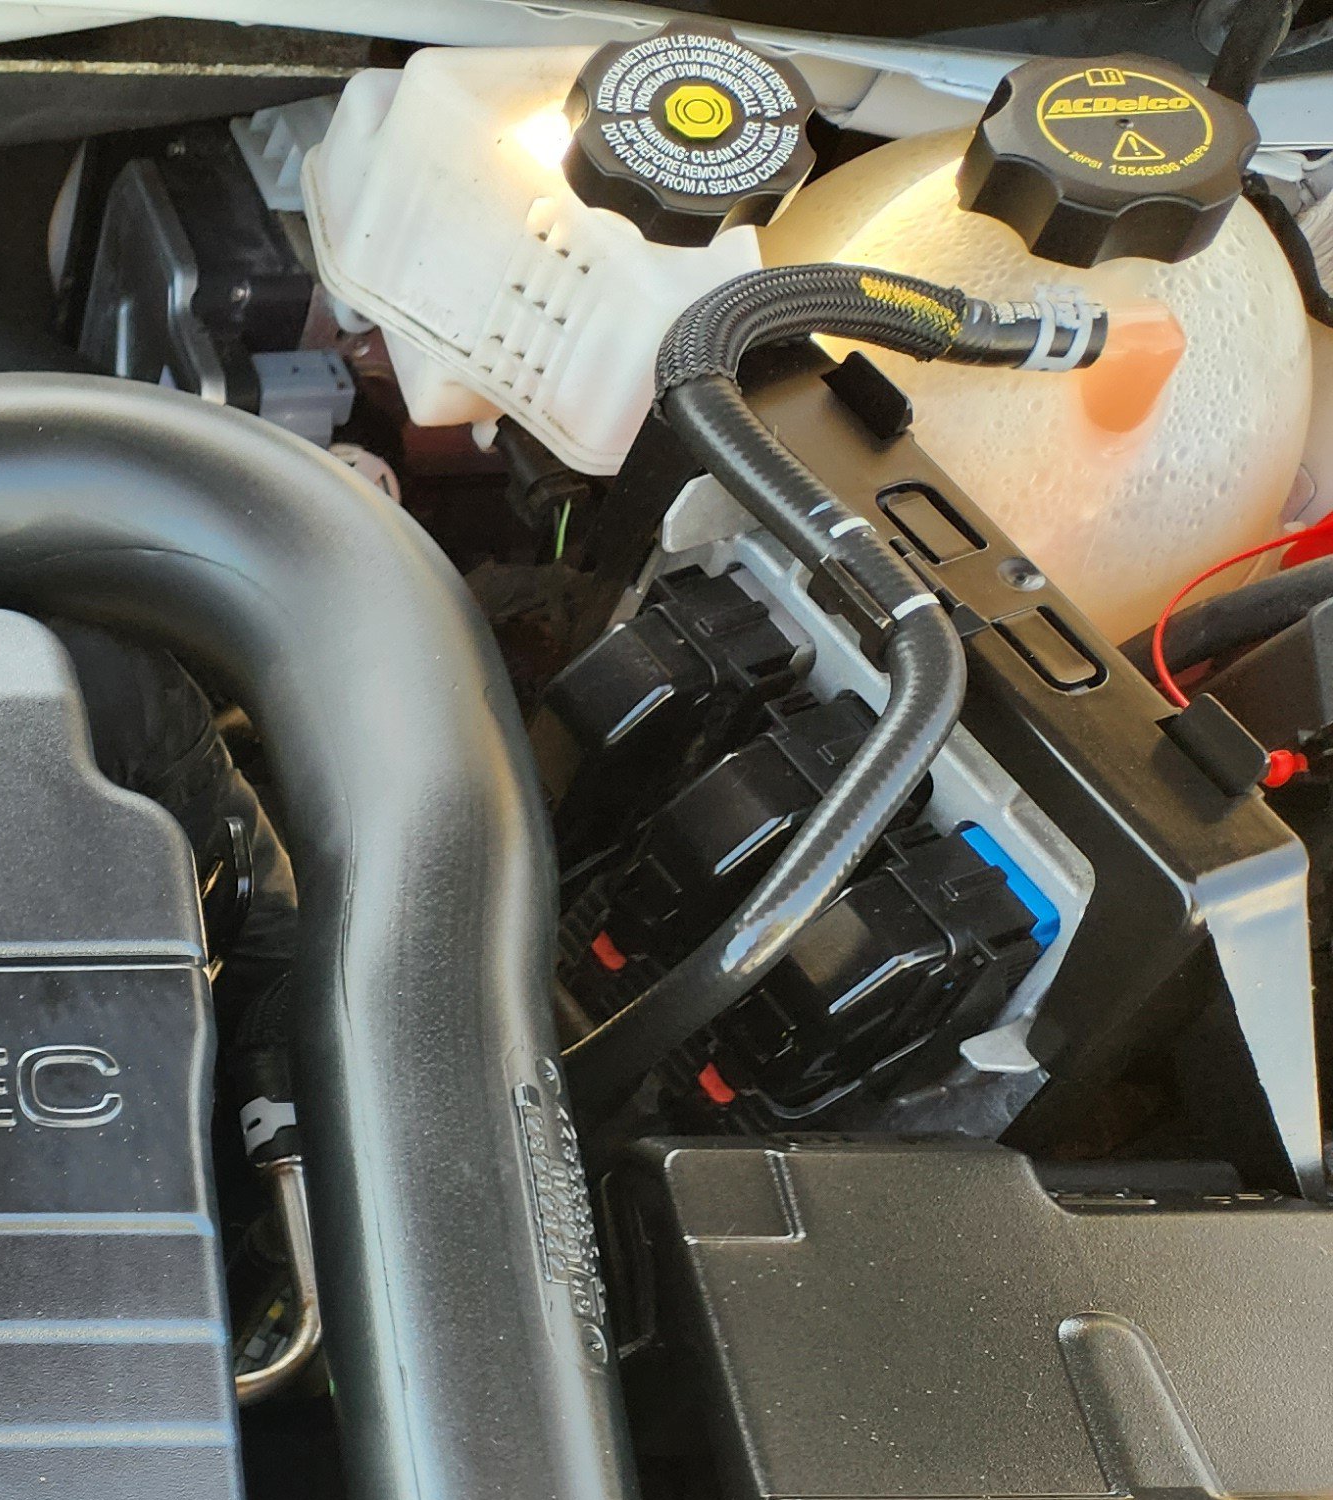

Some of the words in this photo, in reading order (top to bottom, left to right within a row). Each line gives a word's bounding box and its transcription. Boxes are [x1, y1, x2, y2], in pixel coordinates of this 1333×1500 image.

[619, 36, 672, 68] NETTOYER
[671, 35, 687, 48] LE
[687, 34, 742, 57] BOUCHON
[737, 49, 775, 77] AVANT
[645, 53, 670, 71] QUE
[668, 49, 684, 64] DU
[684, 49, 728, 69] LIQUIDE
[724, 59, 745, 75] DE
[738, 66, 769, 96] FREIN
[633, 66, 677, 112] PROVENANT
[701, 65, 735, 88] BIDON
[1047, 95, 1191, 114] ACDelco
[619, 120, 643, 142] CAP
[633, 139, 682, 174] BEFORE
[758, 122, 781, 151] ONLY
[691, 146, 736, 165] CLEAN
[730, 121, 762, 156] FILLER
[619, 149, 658, 178] FLUID
[654, 170, 696, 193] FROM
[696, 180, 709, 194] A
[708, 172, 759, 195] SEALED
